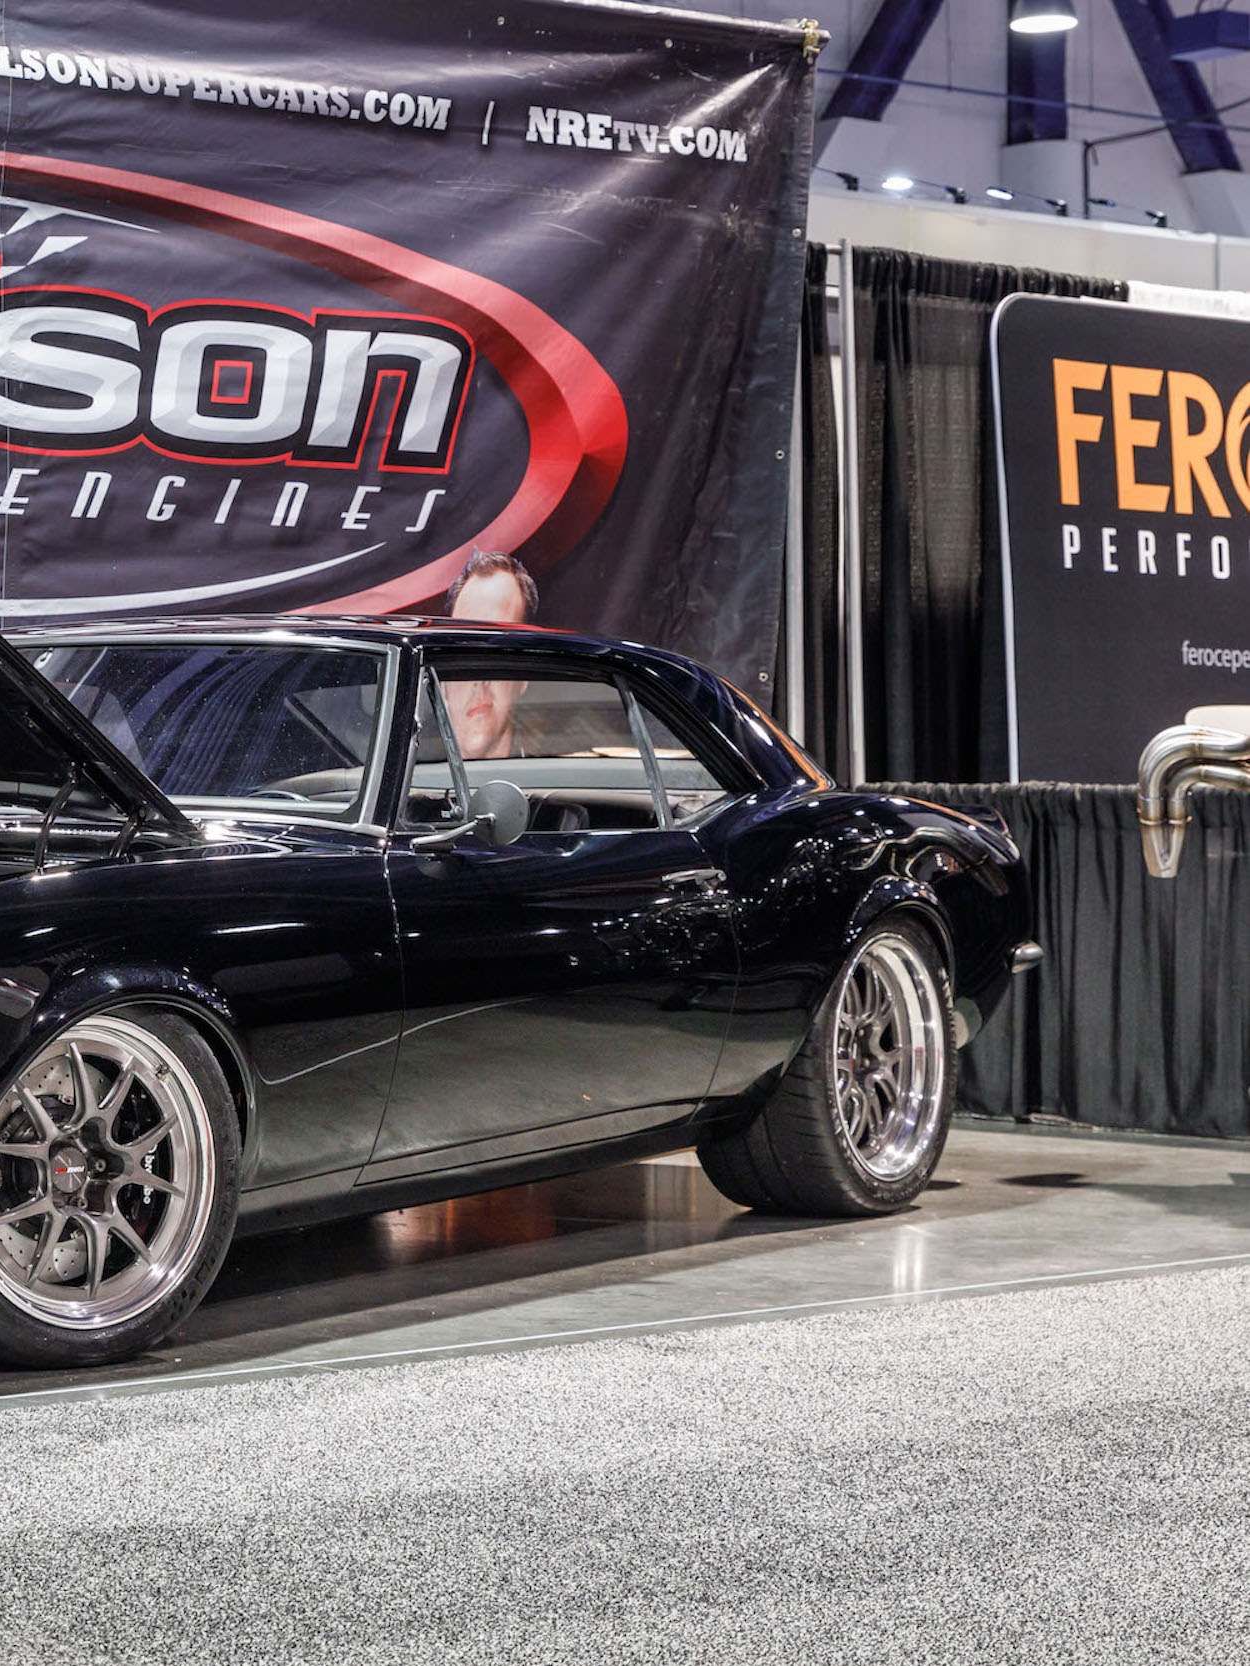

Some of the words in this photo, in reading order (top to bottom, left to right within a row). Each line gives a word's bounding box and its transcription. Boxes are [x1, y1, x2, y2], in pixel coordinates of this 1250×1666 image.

[525, 105, 749, 162] NRETV.COM
[1062, 524, 1250, 580] PERFO
[142, 1154, 155, 1205] brbo
